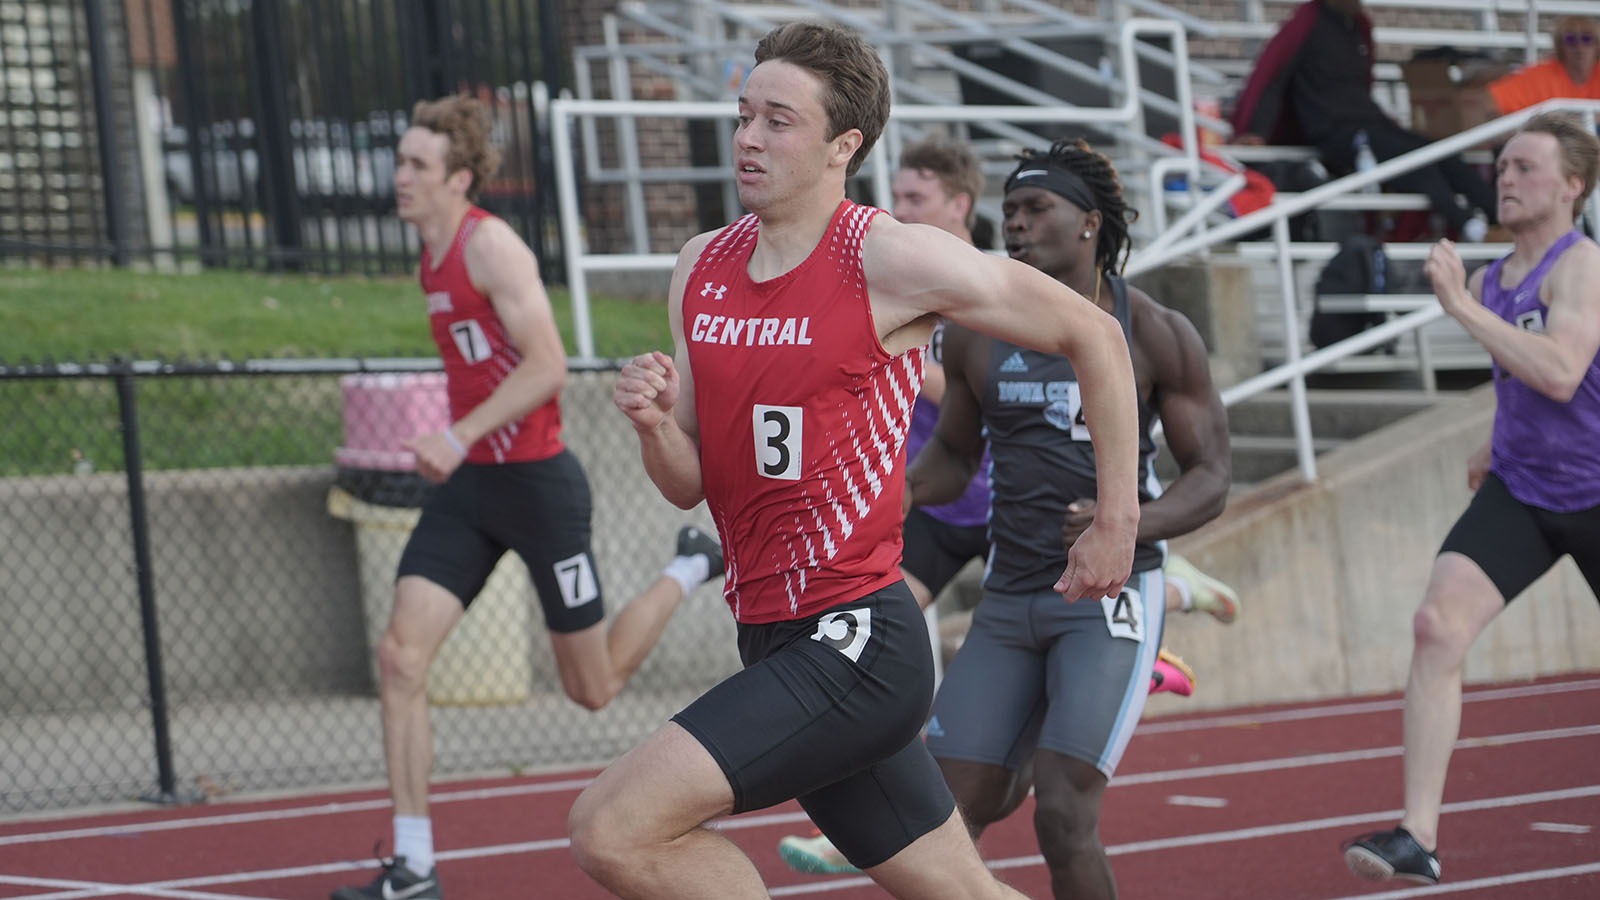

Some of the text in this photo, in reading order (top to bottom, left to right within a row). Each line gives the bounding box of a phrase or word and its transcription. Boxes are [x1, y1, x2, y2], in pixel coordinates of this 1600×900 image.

[455, 325, 476, 361] 7
[691, 313, 812, 346] CENTRAL
[763, 410, 790, 475] 3
[561, 564, 579, 599] 7
[1112, 592, 1138, 633] 4
